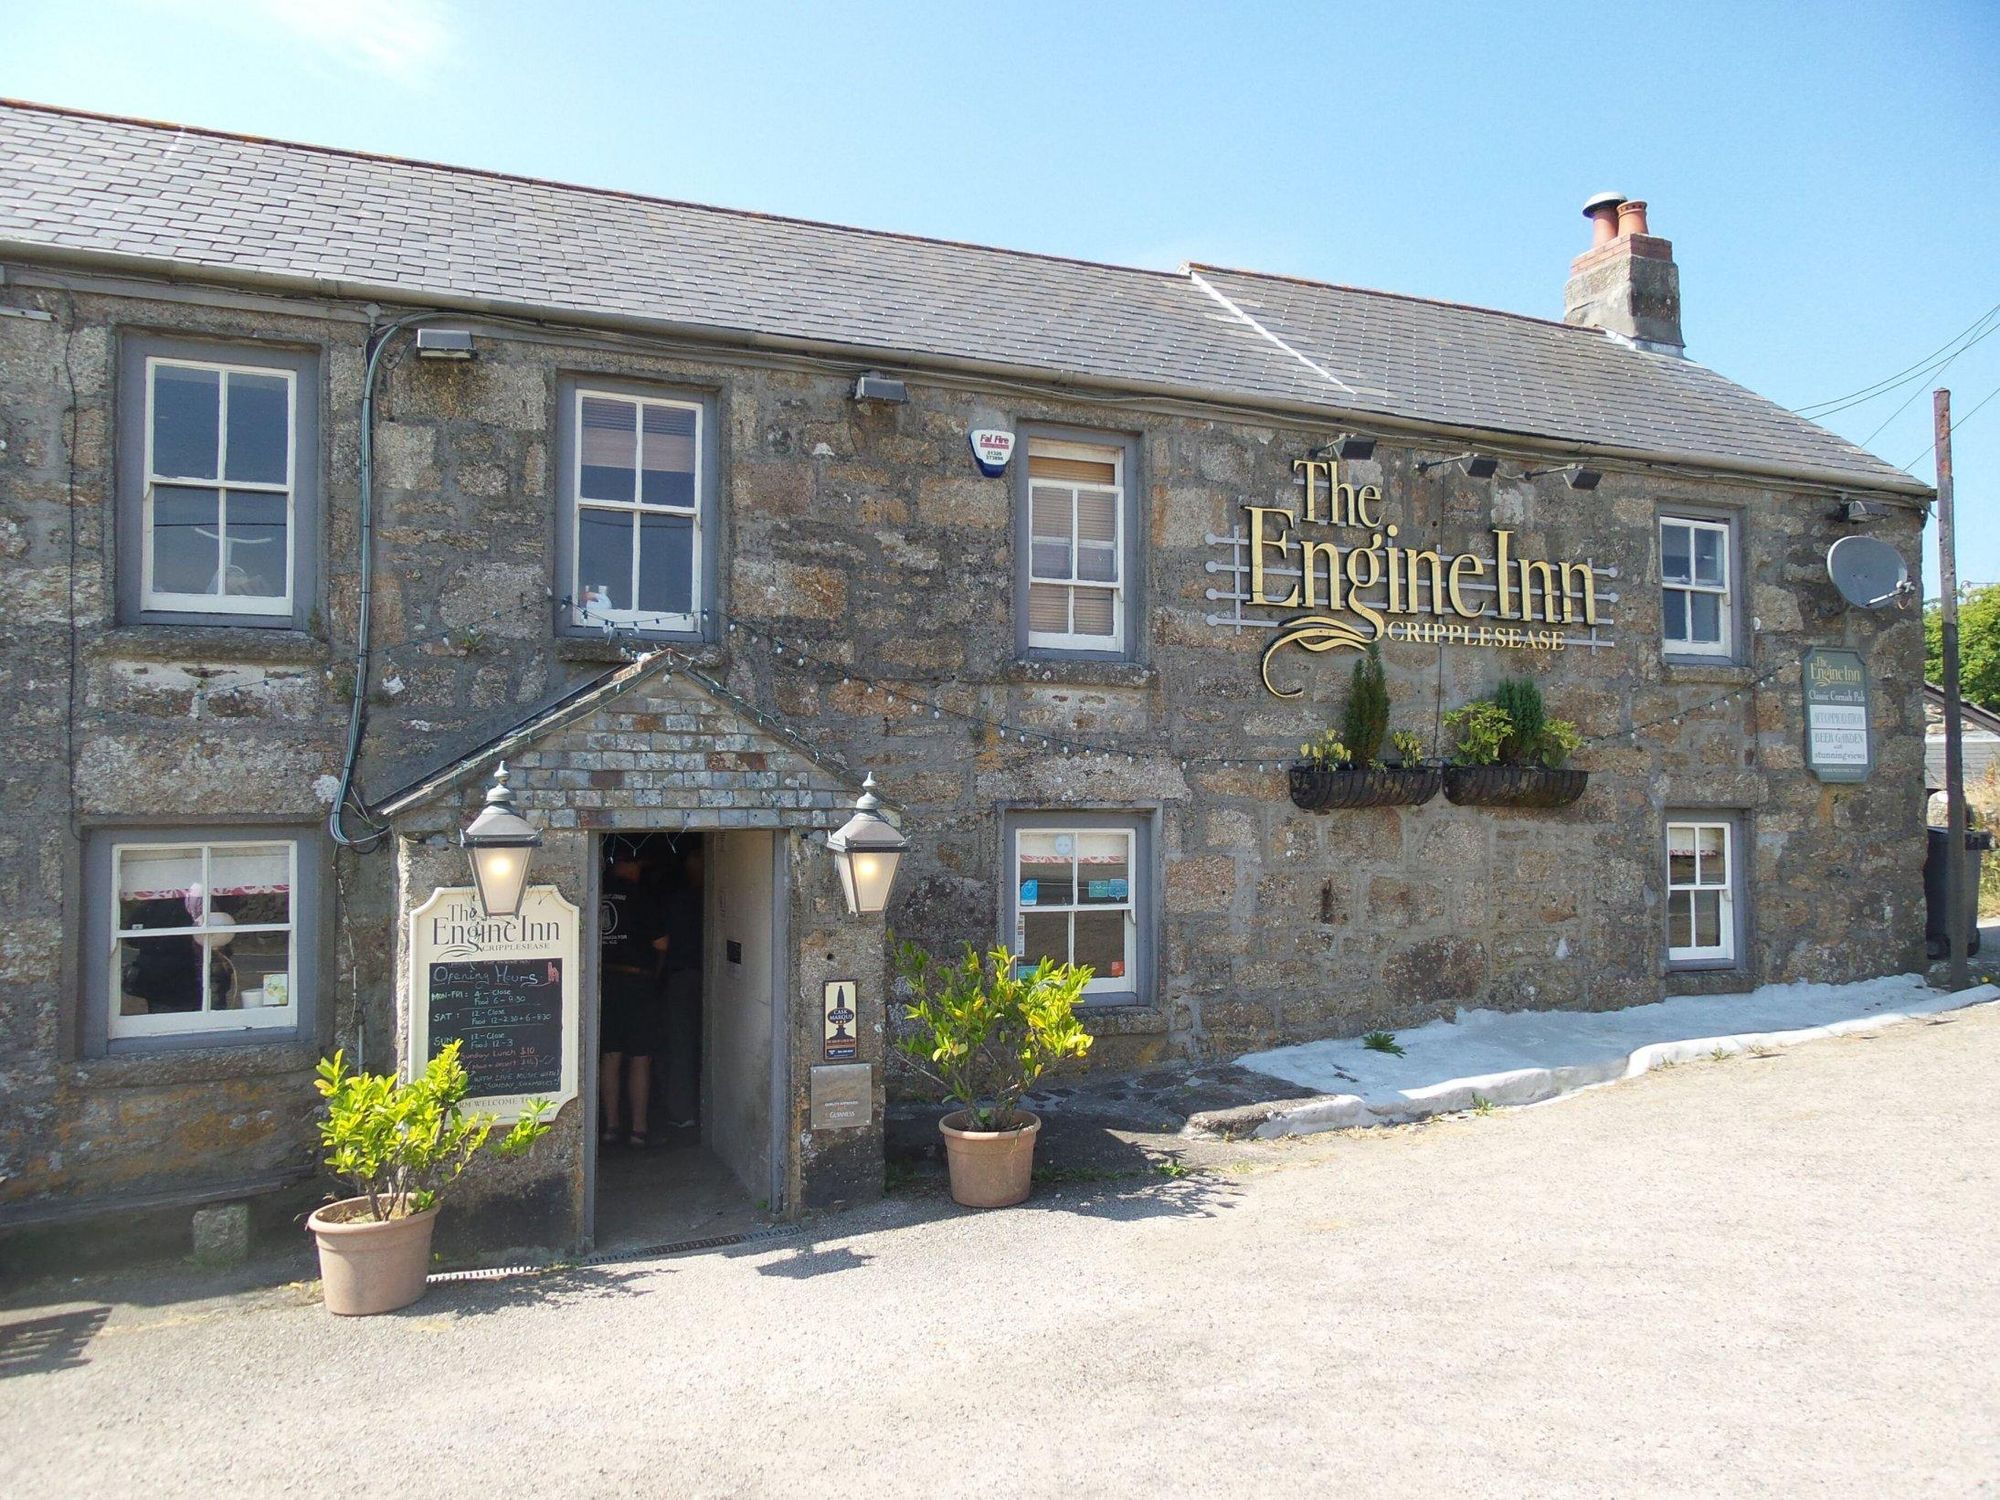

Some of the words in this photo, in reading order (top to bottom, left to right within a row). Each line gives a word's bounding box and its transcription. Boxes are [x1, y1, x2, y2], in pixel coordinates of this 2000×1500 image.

[980, 434, 992, 443] Fal
[994, 435, 1009, 445] Fire
[1293, 459, 1382, 528] The
[1244, 505, 1486, 644] Engine
[1491, 529, 1596, 626] Inn
[1387, 620, 1566, 651] CRIPPLESEASE
[1810, 662, 1843, 684] Engine
[1844, 665, 1860, 682] Inn
[447, 903, 478, 922] The
[432, 917, 516, 952] Engine
[520, 915, 560, 941] Inn
[480, 942, 551, 952] CRIPPLESEASE
[433, 965, 489, 985] Opening
[495, 964, 538, 984] Hours
[493, 1048, 516, 1058] Lunch
[474, 1097, 517, 1107] WELCOME
